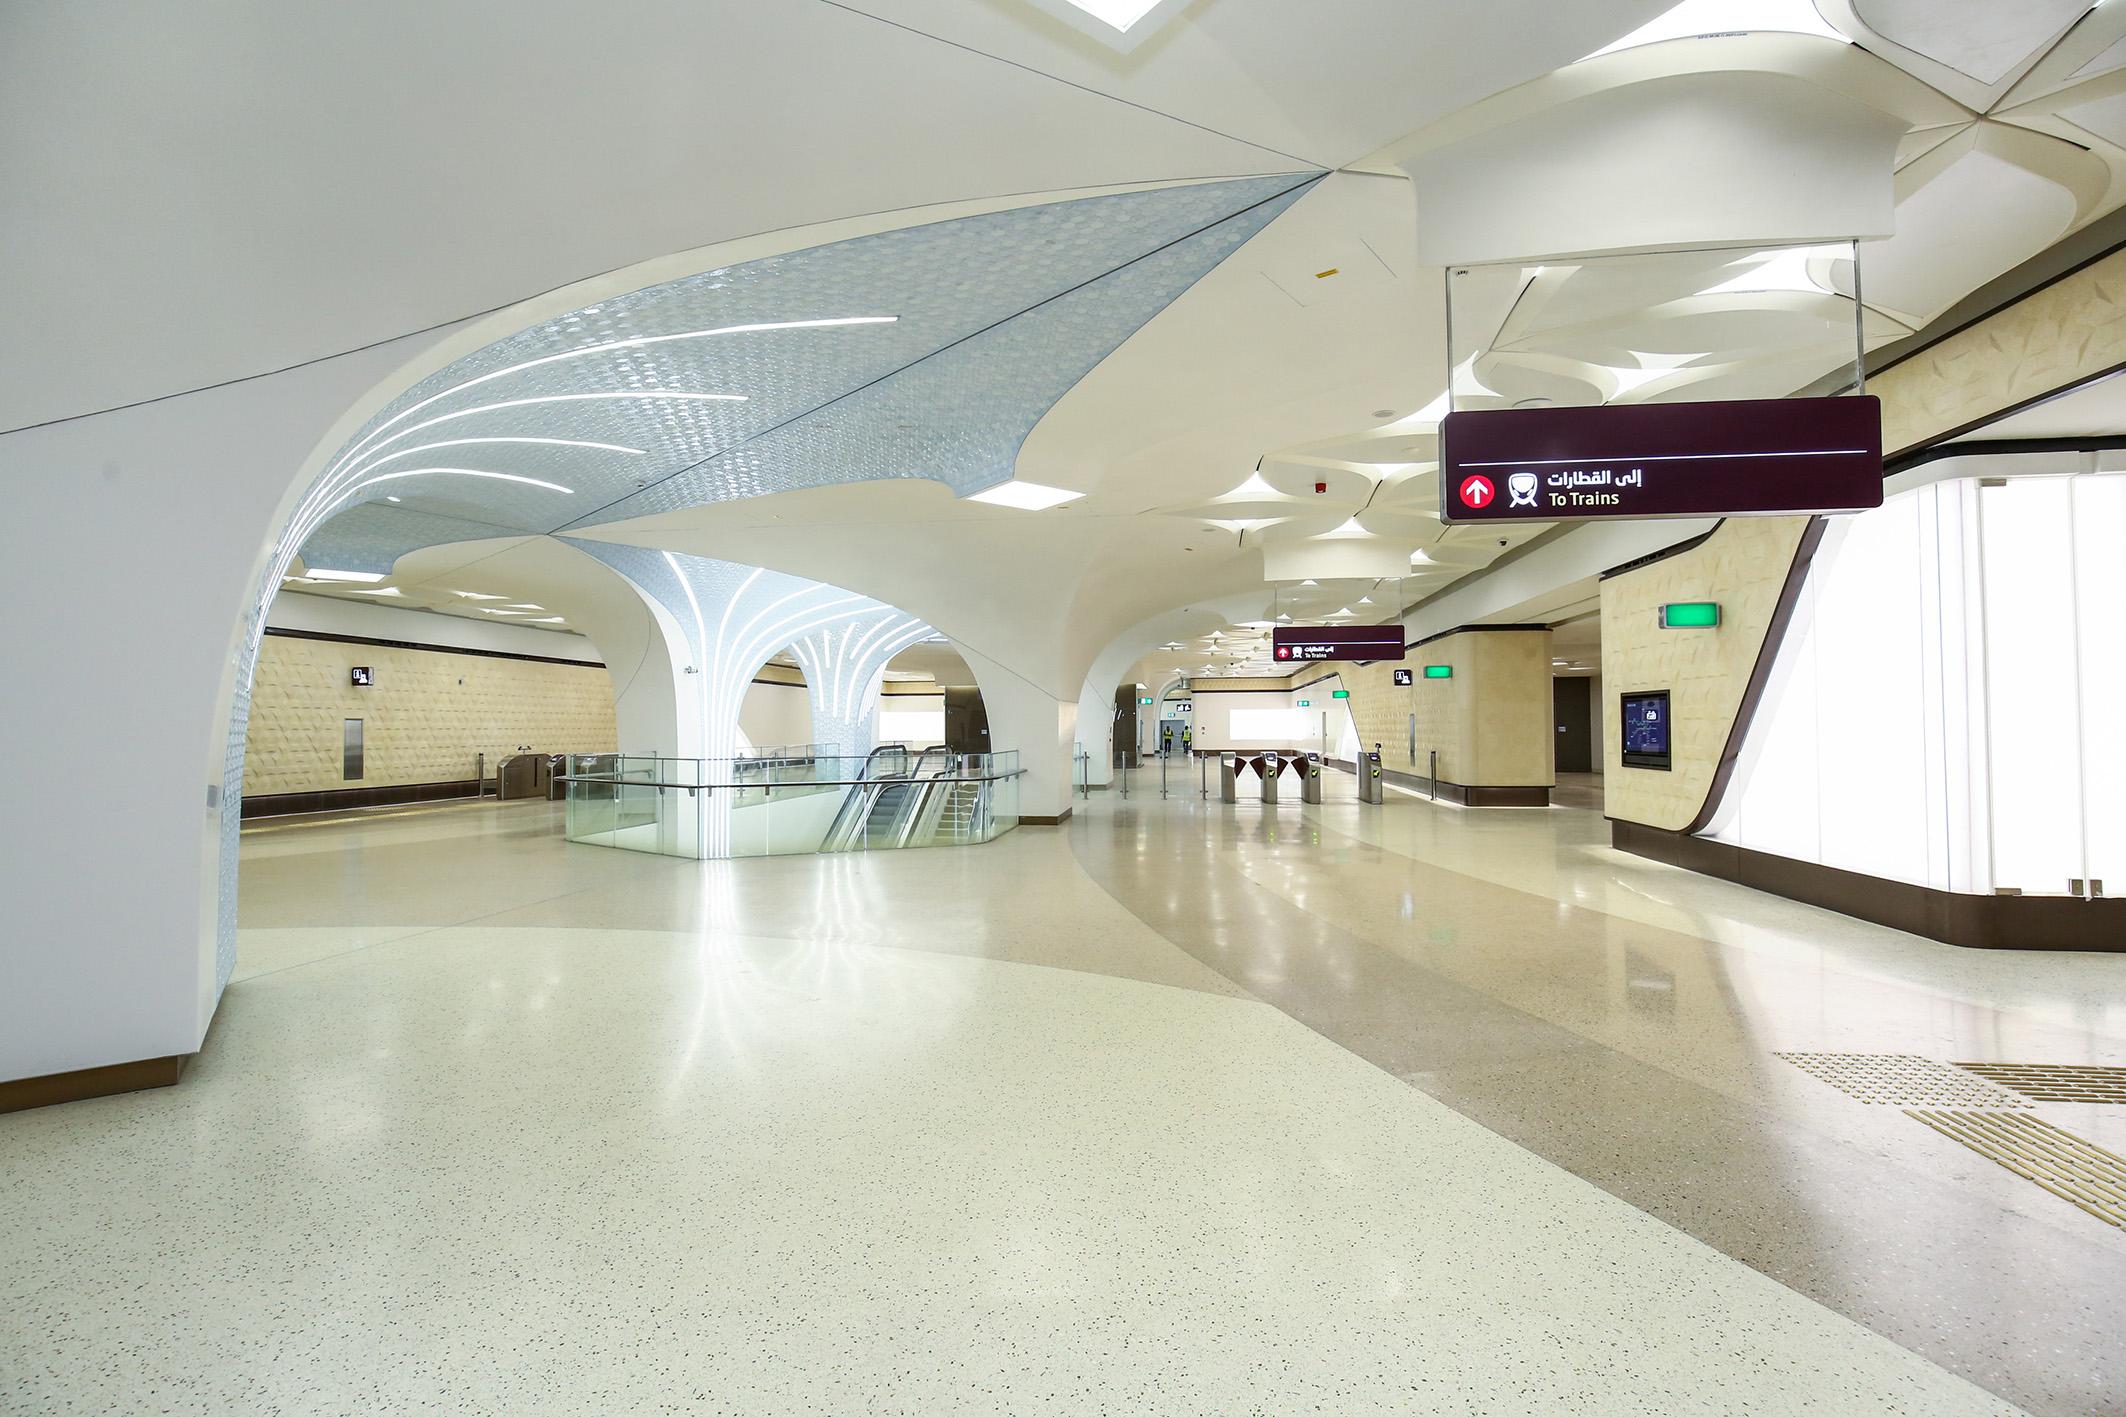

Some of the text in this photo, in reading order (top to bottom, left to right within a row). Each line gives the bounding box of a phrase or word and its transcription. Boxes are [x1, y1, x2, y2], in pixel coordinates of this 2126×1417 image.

[1547, 469, 1642, 489] إلى القطارات
[1548, 491, 1620, 506] To Trains
